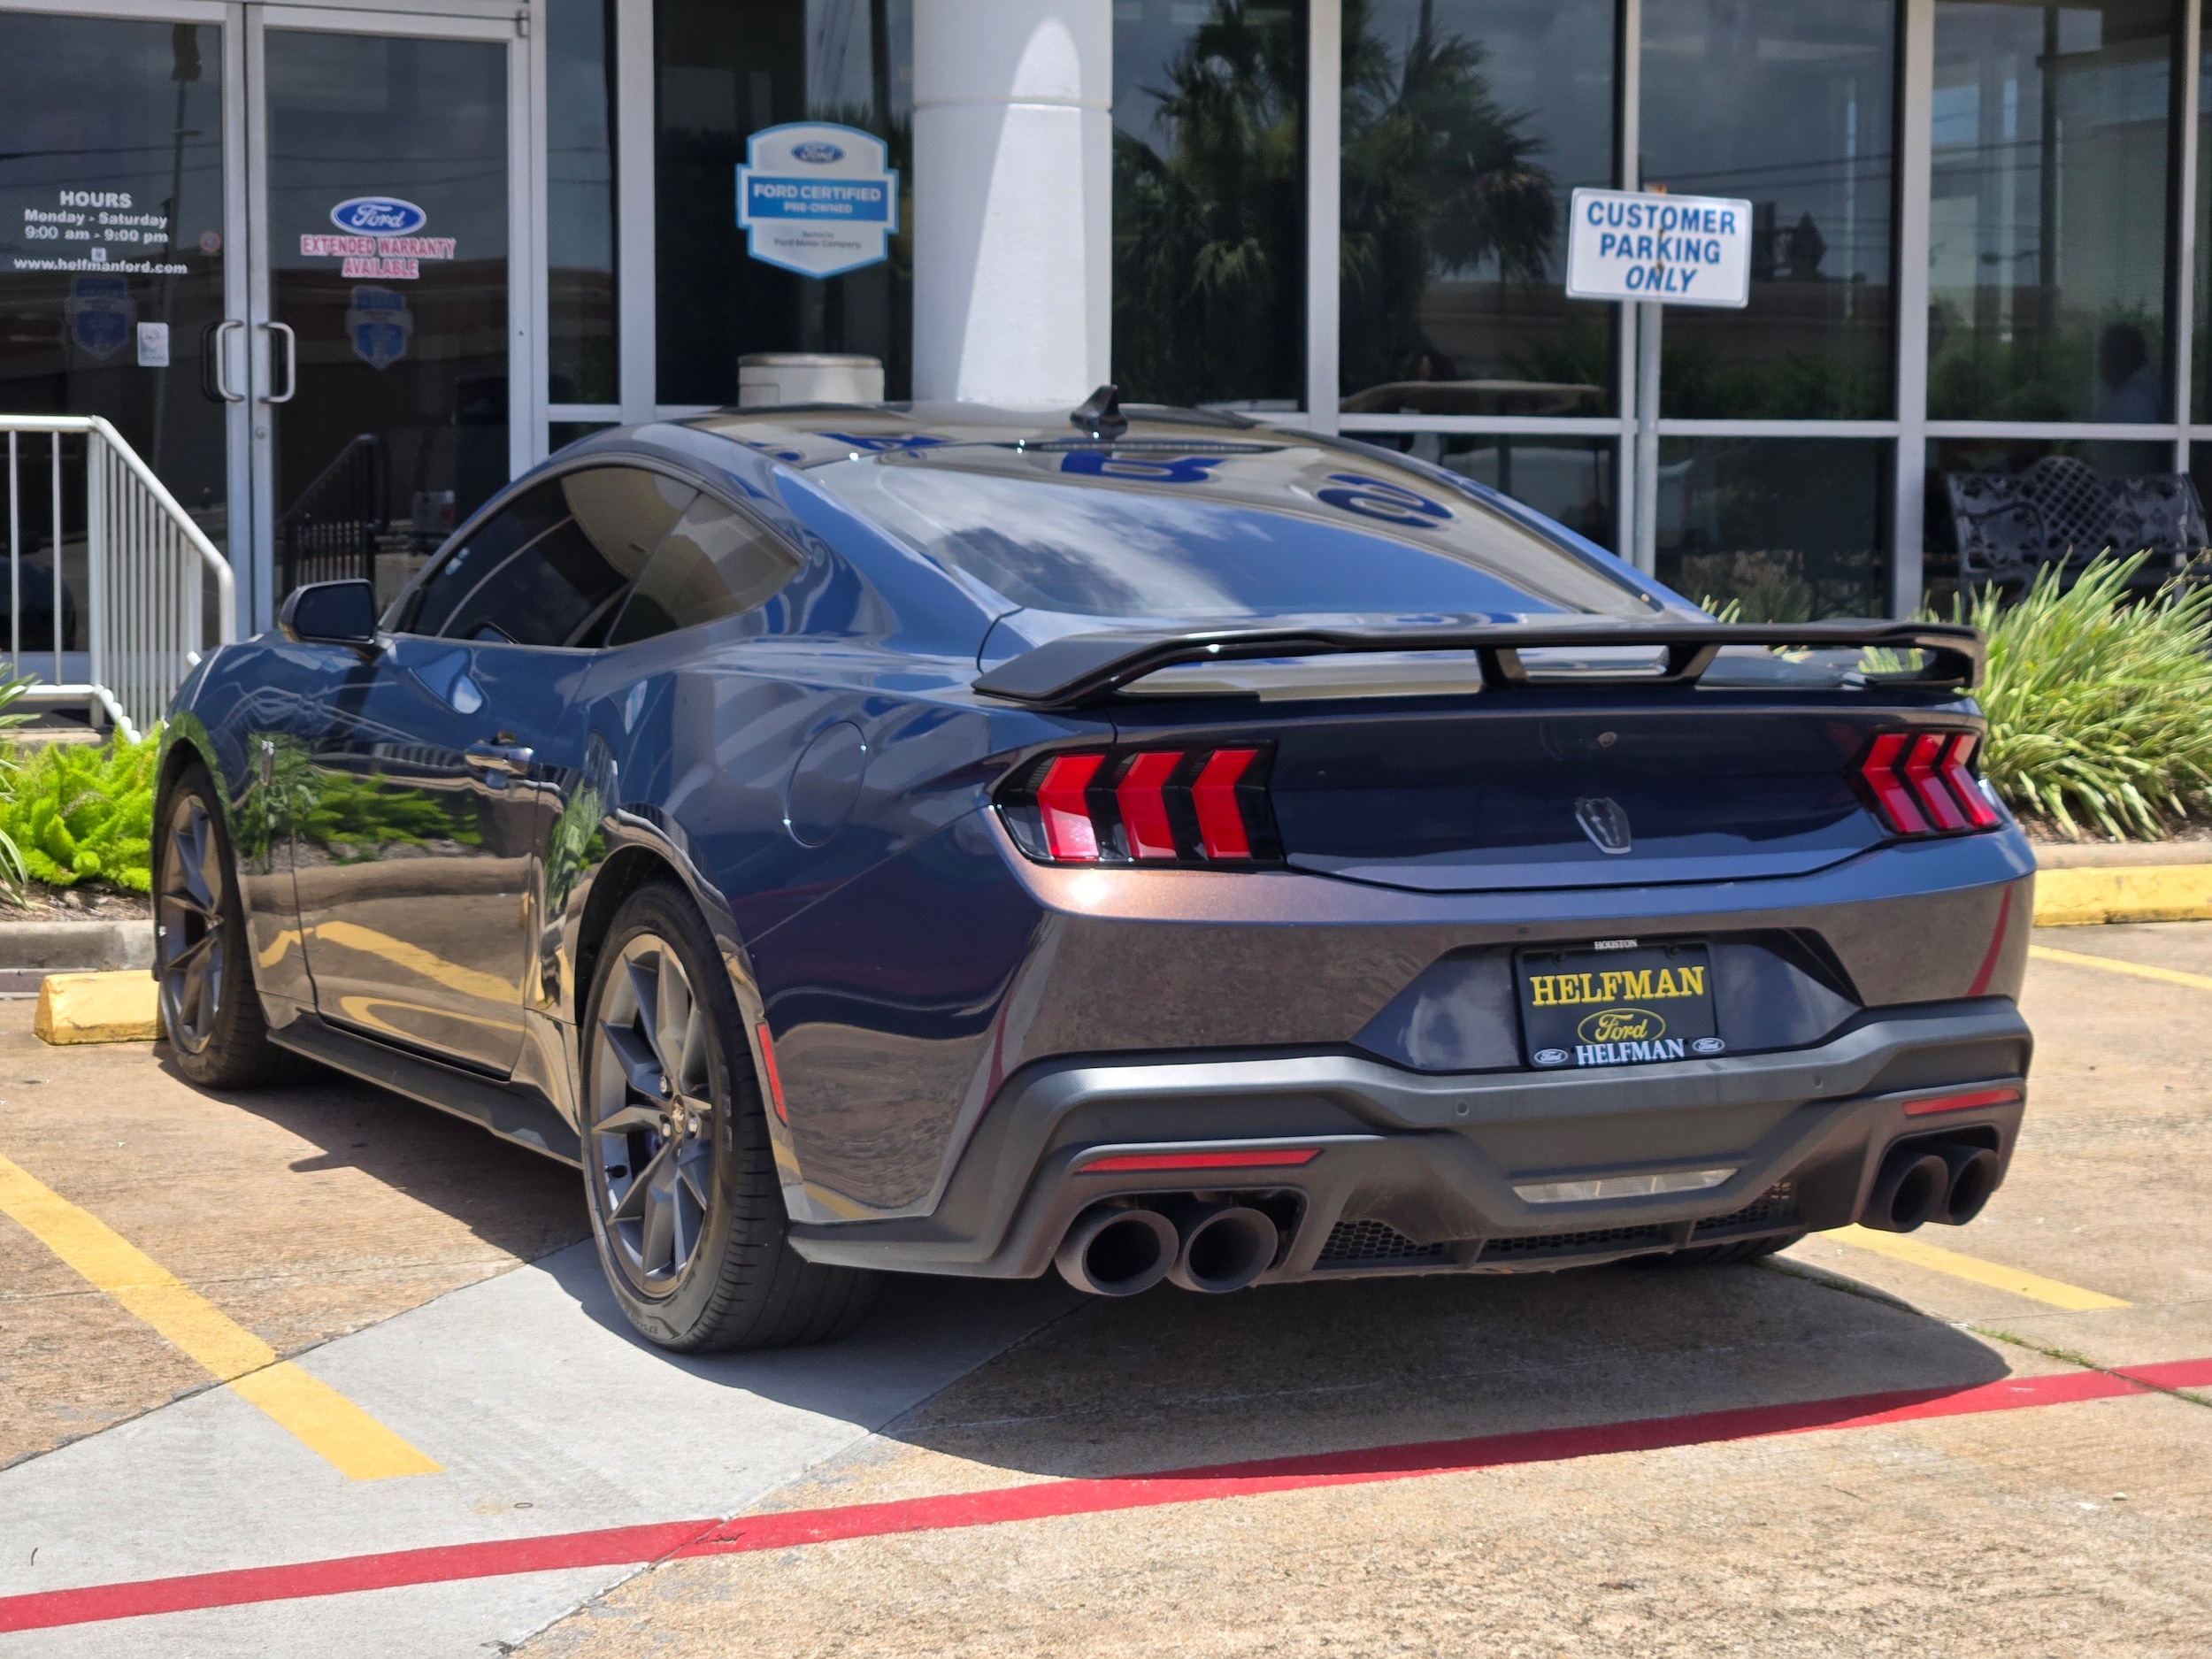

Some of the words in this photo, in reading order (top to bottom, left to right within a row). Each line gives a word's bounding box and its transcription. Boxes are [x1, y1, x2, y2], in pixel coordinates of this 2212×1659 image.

[59, 189, 133, 209] HOURS
[754, 183, 798, 199] FORD
[800, 185, 882, 203] CERTIFIED
[24, 209, 86, 227] Monday
[98, 211, 168, 229] Saturday
[350, 204, 407, 228] Ford
[783, 201, 854, 214] PRE-OWNED
[1586, 200, 1736, 235] CUSTOMER
[24, 225, 59, 241] 9:00
[64, 229, 90, 241] am
[104, 228, 140, 242] 9:00
[142, 231, 169, 245] pm
[301, 234, 376, 257] EXTENDED
[378, 236, 457, 260] WARRANTY
[1599, 233, 1721, 265] PARKING
[13, 257, 188, 275] www.helfmanford.com
[342, 257, 420, 280] AVAILABLE
[1625, 265, 1698, 293] ONLY
[1594, 939, 1639, 950] HOUSTON
[1529, 965, 1705, 1006] HELFMAN
[1594, 1013, 1648, 1042] Ford
[1575, 1038, 1686, 1067] HELFMAN
